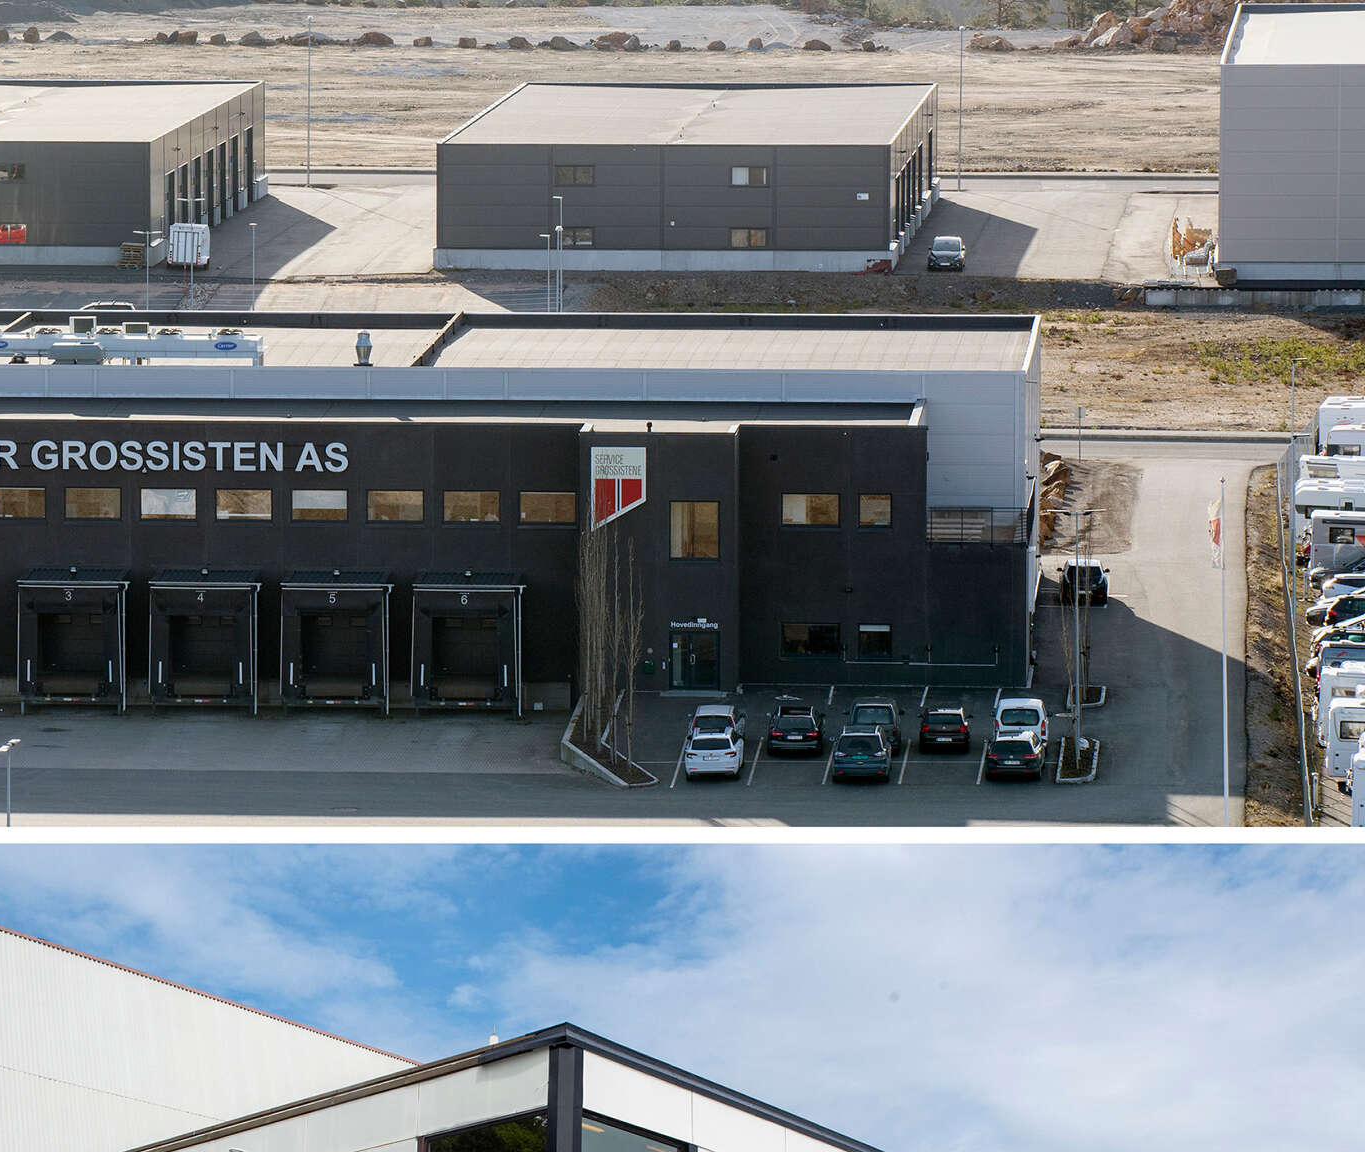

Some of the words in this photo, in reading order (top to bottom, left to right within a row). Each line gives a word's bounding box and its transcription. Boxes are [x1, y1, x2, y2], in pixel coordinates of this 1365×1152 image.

[30, 439, 283, 472] GROSSISTEN
[295, 441, 349, 472] AS
[595, 455, 623, 464] SERVICE
[595, 465, 642, 476] GROSSISTENE
[64, 591, 72, 601] 3
[197, 592, 205, 603] 4
[328, 593, 337, 604] 5
[460, 594, 469, 605] 6
[670, 621, 719, 630] Hovedinngang
